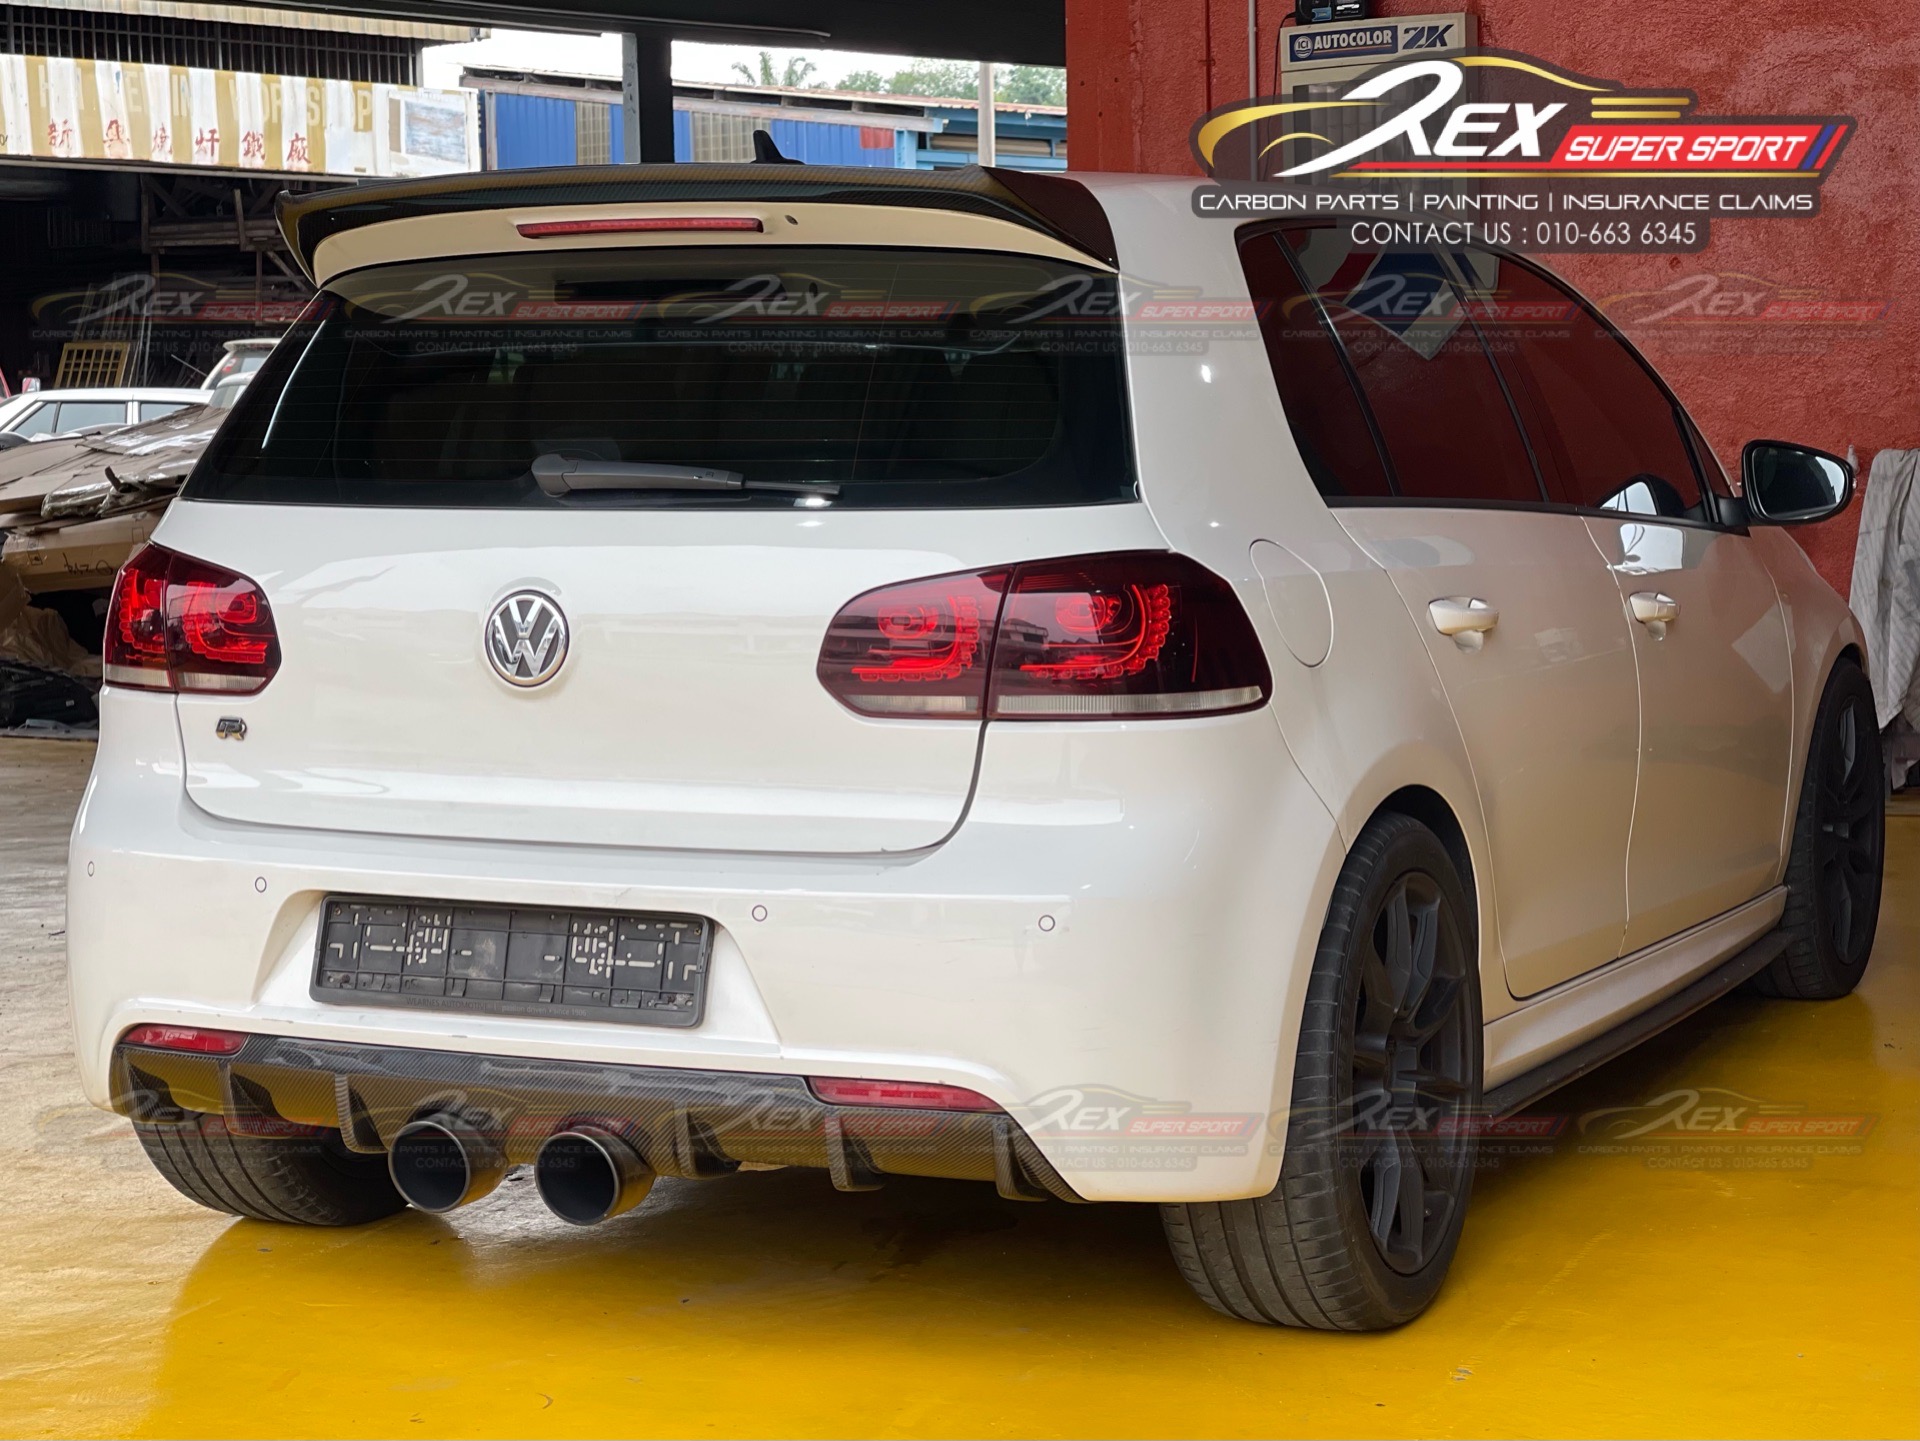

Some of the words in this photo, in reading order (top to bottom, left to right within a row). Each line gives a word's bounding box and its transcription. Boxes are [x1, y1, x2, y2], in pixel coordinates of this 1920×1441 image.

[1298, 39, 1310, 49] ICI
[1314, 30, 1392, 50] AUTOCOLOR
[1402, 24, 1454, 50] 2K
[215, 715, 248, 741] R
[406, 997, 440, 1007] WEARNES
